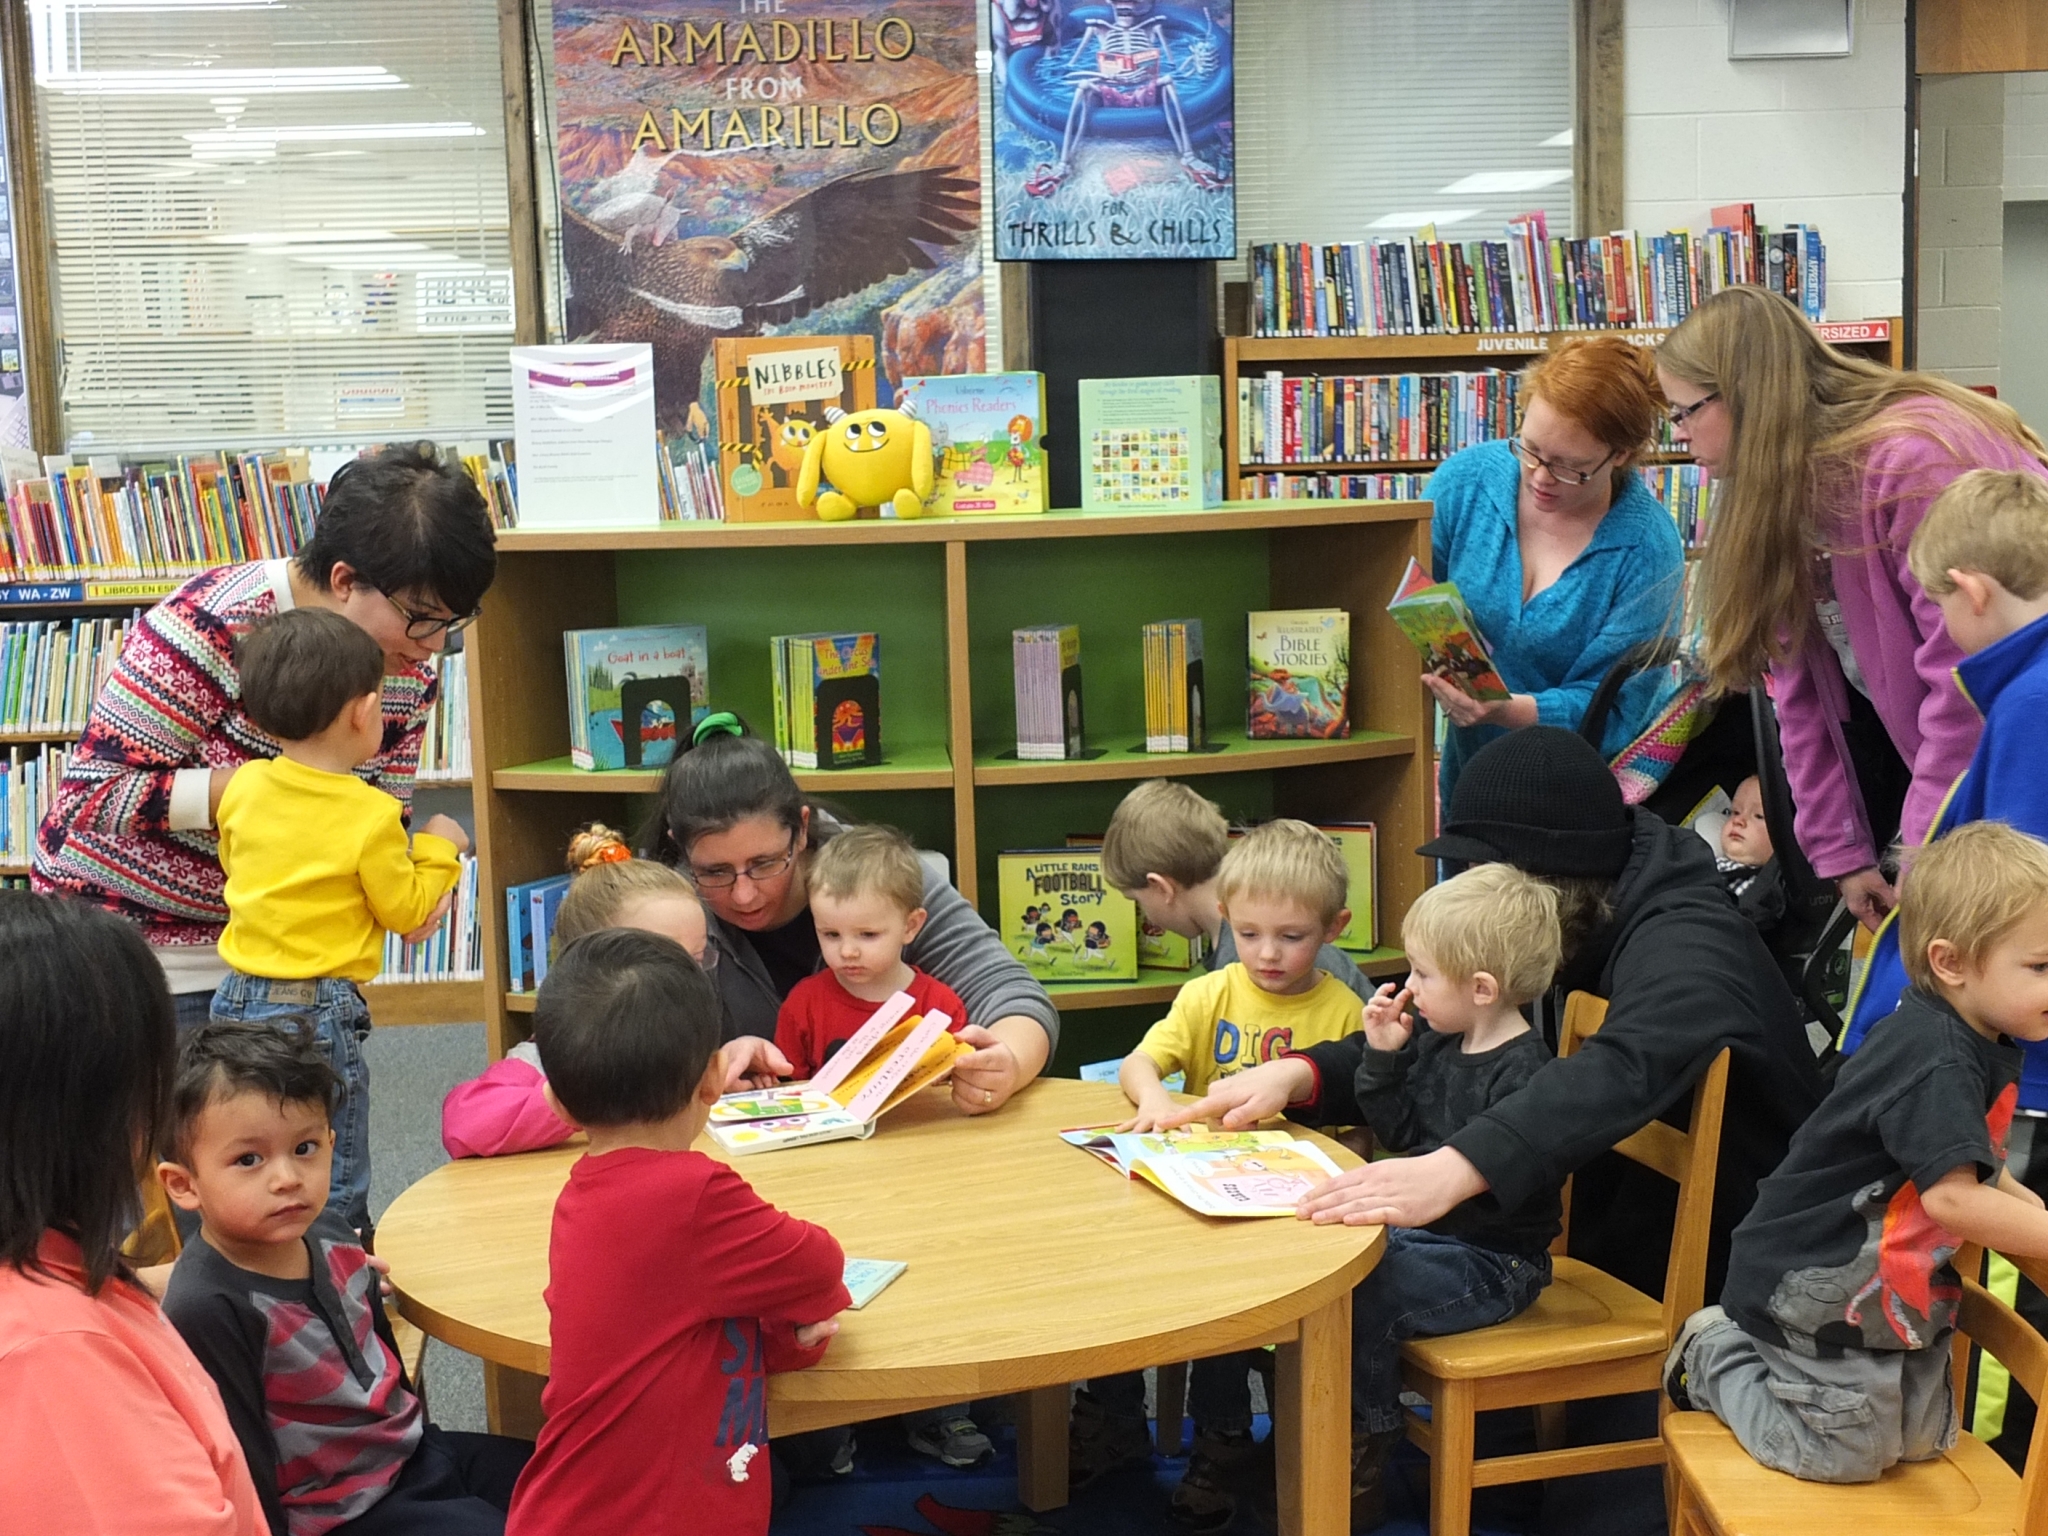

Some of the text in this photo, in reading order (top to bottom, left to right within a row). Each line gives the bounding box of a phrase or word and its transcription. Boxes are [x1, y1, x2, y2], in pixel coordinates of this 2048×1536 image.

[611, 17, 914, 66] ARMADILLO
[726, 76, 803, 100] FROM
[631, 103, 901, 150] AMARILLO
[1101, 200, 1129, 216] FOR
[1008, 218, 1221, 248] THRILLS & CHILLS
[1477, 338, 1548, 351] JUVENILE
[755, 359, 836, 389] NIBBLES
[926, 397, 1016, 414] Phonics Readers
[103, 585, 139, 595] LIBROS
[142, 584, 156, 593] EN
[1281, 635, 1321, 651] BIBLE
[608, 647, 685, 664] Goat in a boat
[824, 649, 840, 659] The
[1273, 649, 1327, 666] STORIES
[1026, 867, 1037, 881] A
[1034, 872, 1107, 896] FOOTBALL
[1060, 893, 1105, 906] Story
[1214, 1018, 1293, 1066] DIG
